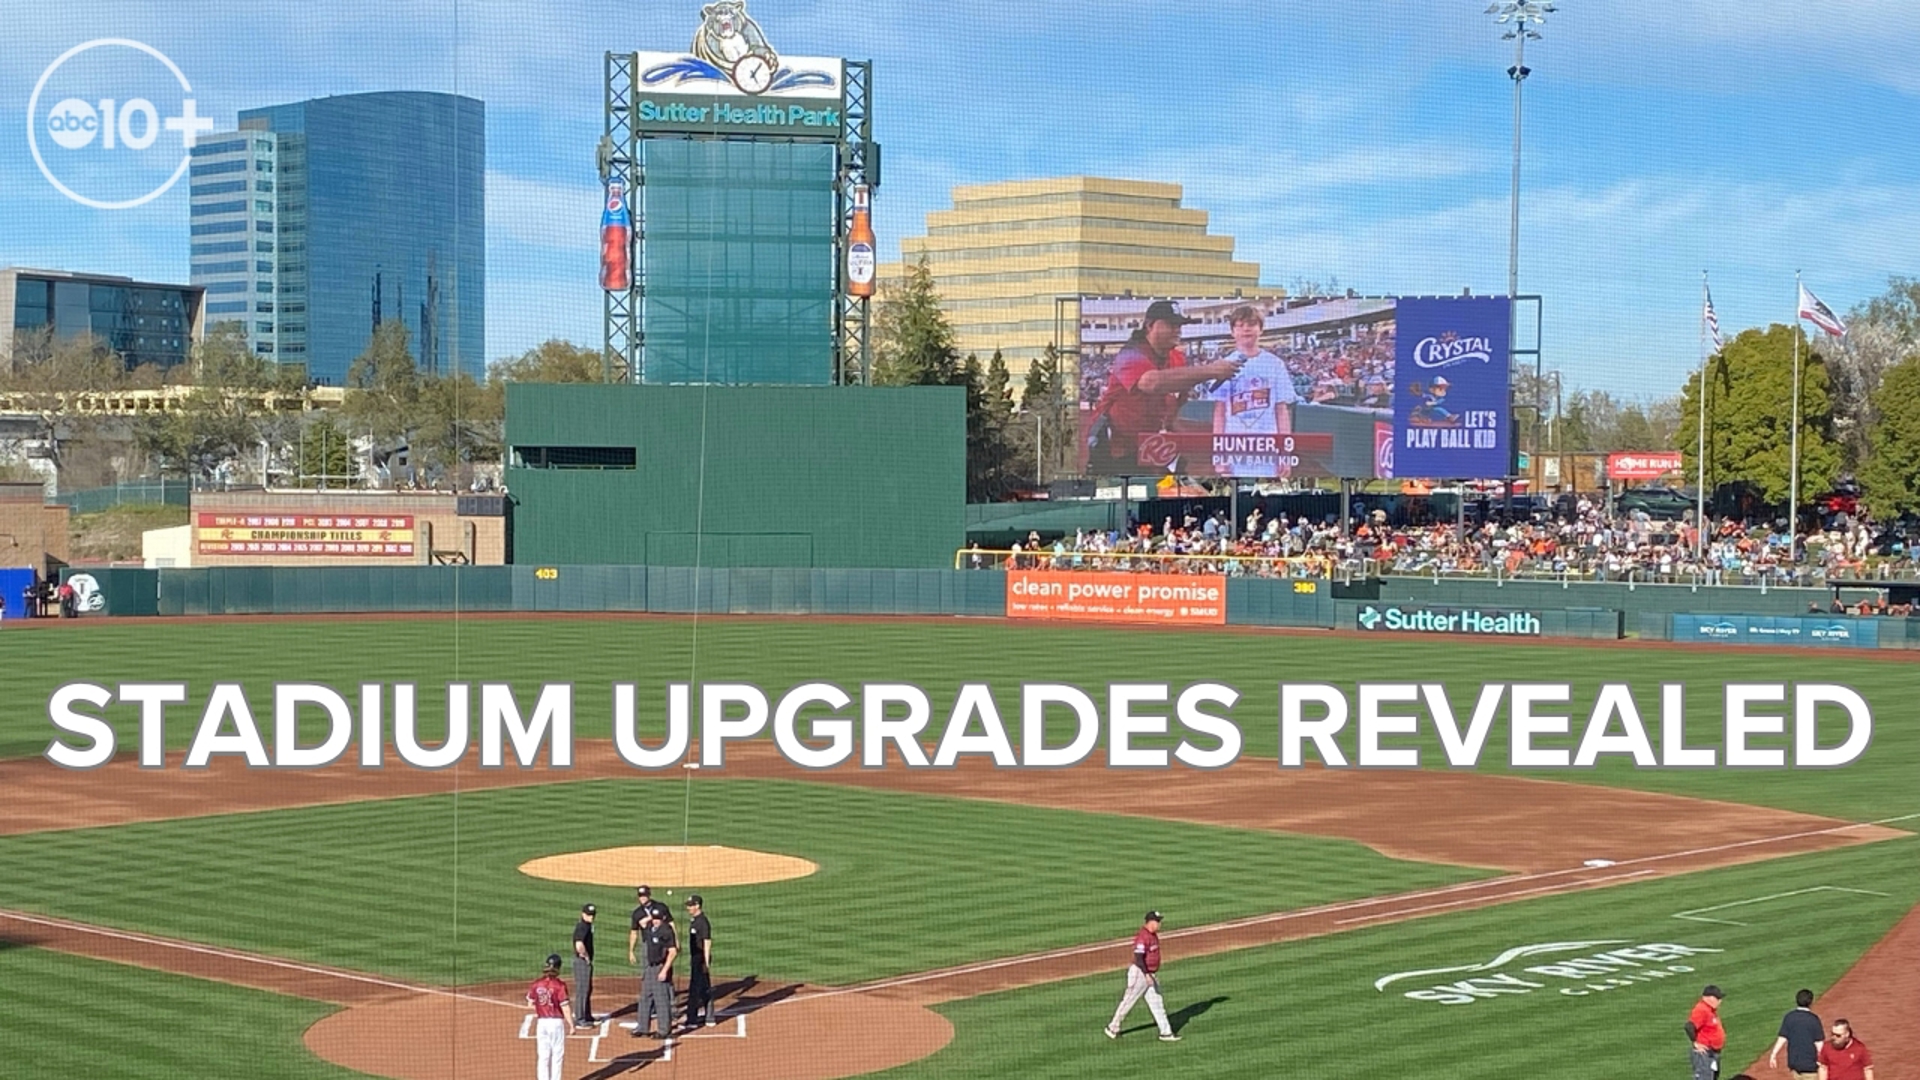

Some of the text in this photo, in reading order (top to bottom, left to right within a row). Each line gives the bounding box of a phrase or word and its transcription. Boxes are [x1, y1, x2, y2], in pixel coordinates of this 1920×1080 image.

[638, 100, 840, 127] Sutter Health Park
[1465, 410, 1497, 428] LET'S
[1212, 437, 1295, 454] HUNTER, 9
[1406, 428, 1496, 448] PLAY BALL KID
[1212, 455, 1299, 467] PLAY BALL KID
[251, 530, 327, 540] CHAMPIONSHIP
[330, 531, 362, 541] TITLES
[535, 567, 559, 580] 403
[1012, 575, 1219, 604] clean power promise
[1012, 602, 1027, 611] low
[1122, 605, 1144, 614] clean
[1145, 608, 1175, 618] energy
[1190, 607, 1218, 616] SMUD
[1385, 608, 1541, 635] Sutter Health
[1404, 943, 1724, 1005] SKY RIVER
